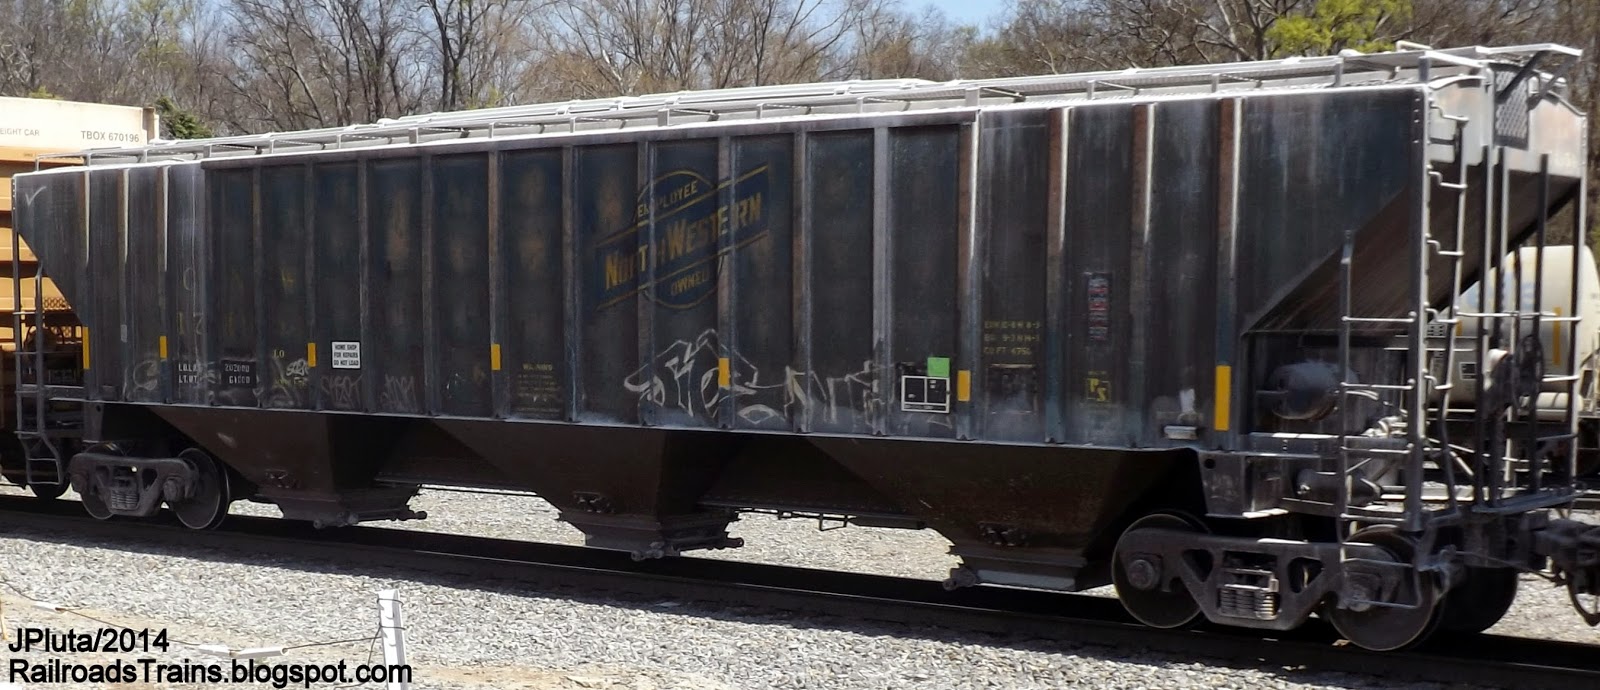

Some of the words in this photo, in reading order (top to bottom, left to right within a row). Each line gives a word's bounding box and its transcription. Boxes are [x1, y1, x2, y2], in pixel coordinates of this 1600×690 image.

[24, 128, 40, 137] CAR
[81, 130, 106, 141] TBOX
[108, 132, 140, 143] 670196
